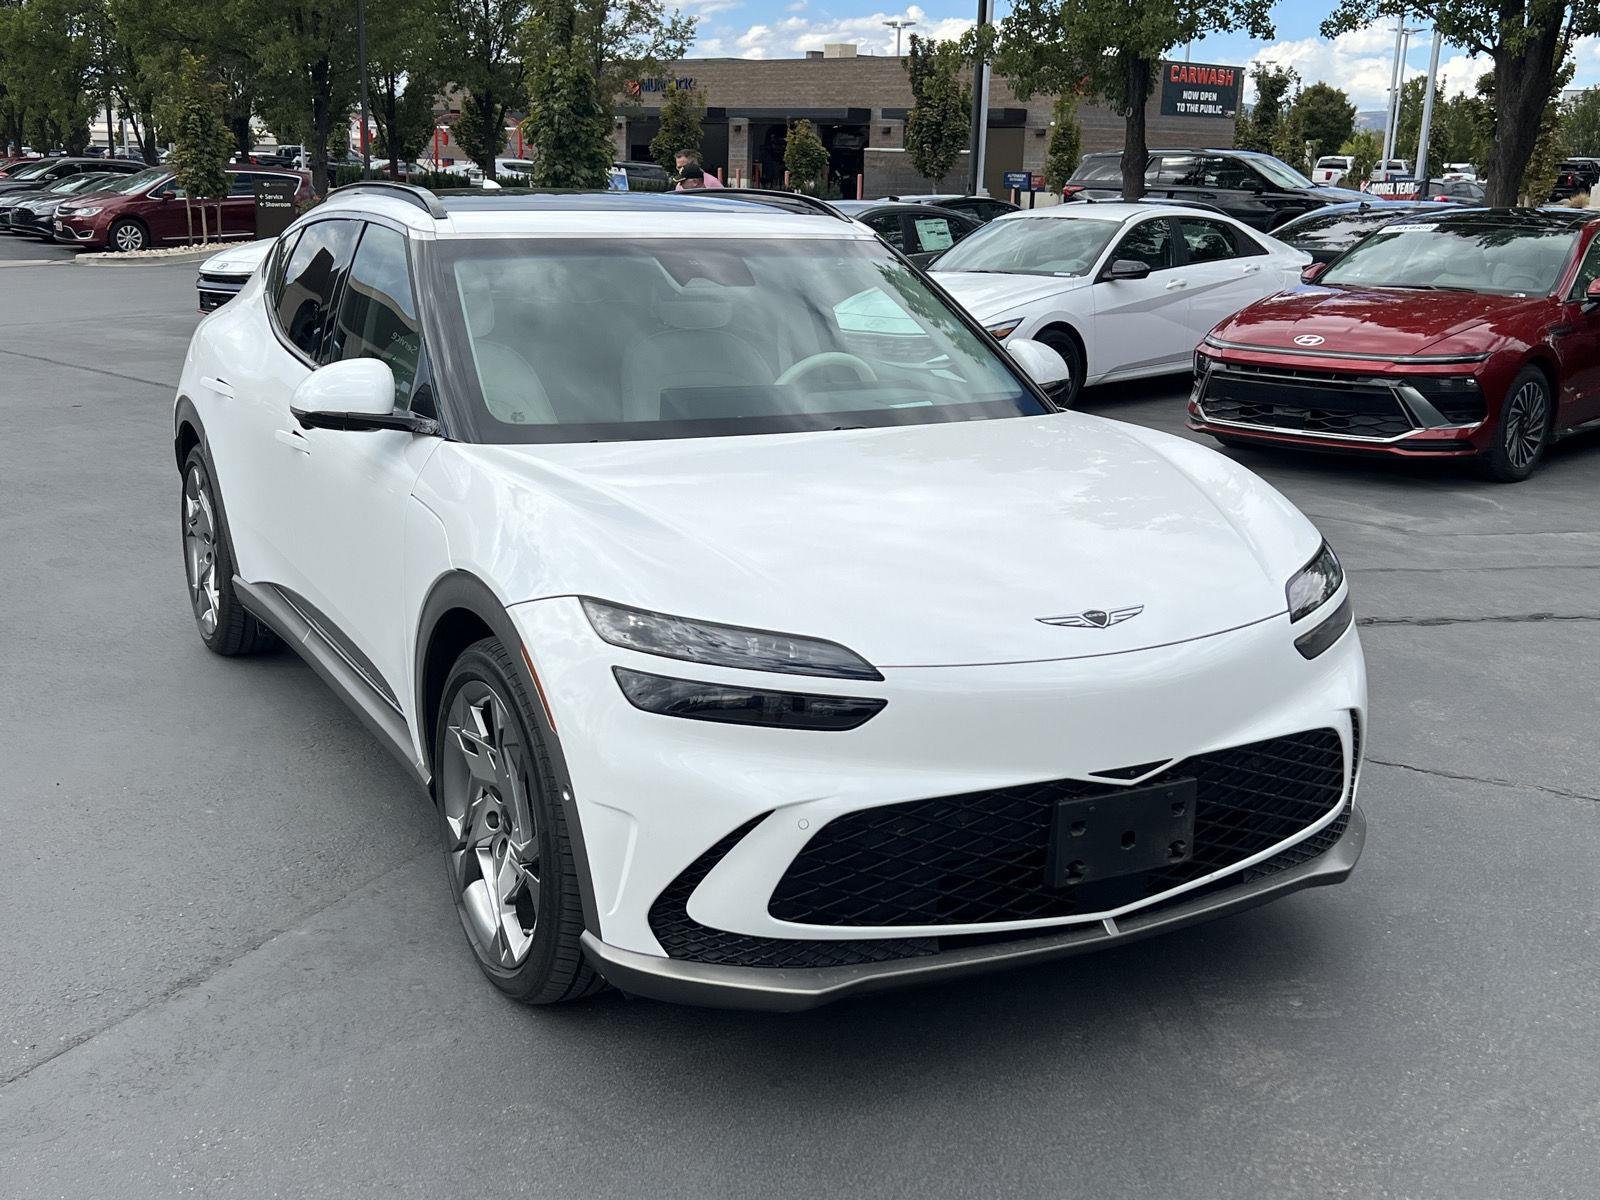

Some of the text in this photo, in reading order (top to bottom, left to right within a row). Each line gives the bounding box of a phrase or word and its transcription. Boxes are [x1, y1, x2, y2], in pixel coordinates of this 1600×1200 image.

[1170, 65, 1234, 87] CARWASH
[641, 78, 693, 92] MURCK
[1183, 91, 1217, 101] NOW OPEN
[1177, 103, 1222, 114] TO THE PUBLIC
[1370, 182, 1414, 195] MODEL YEAR
